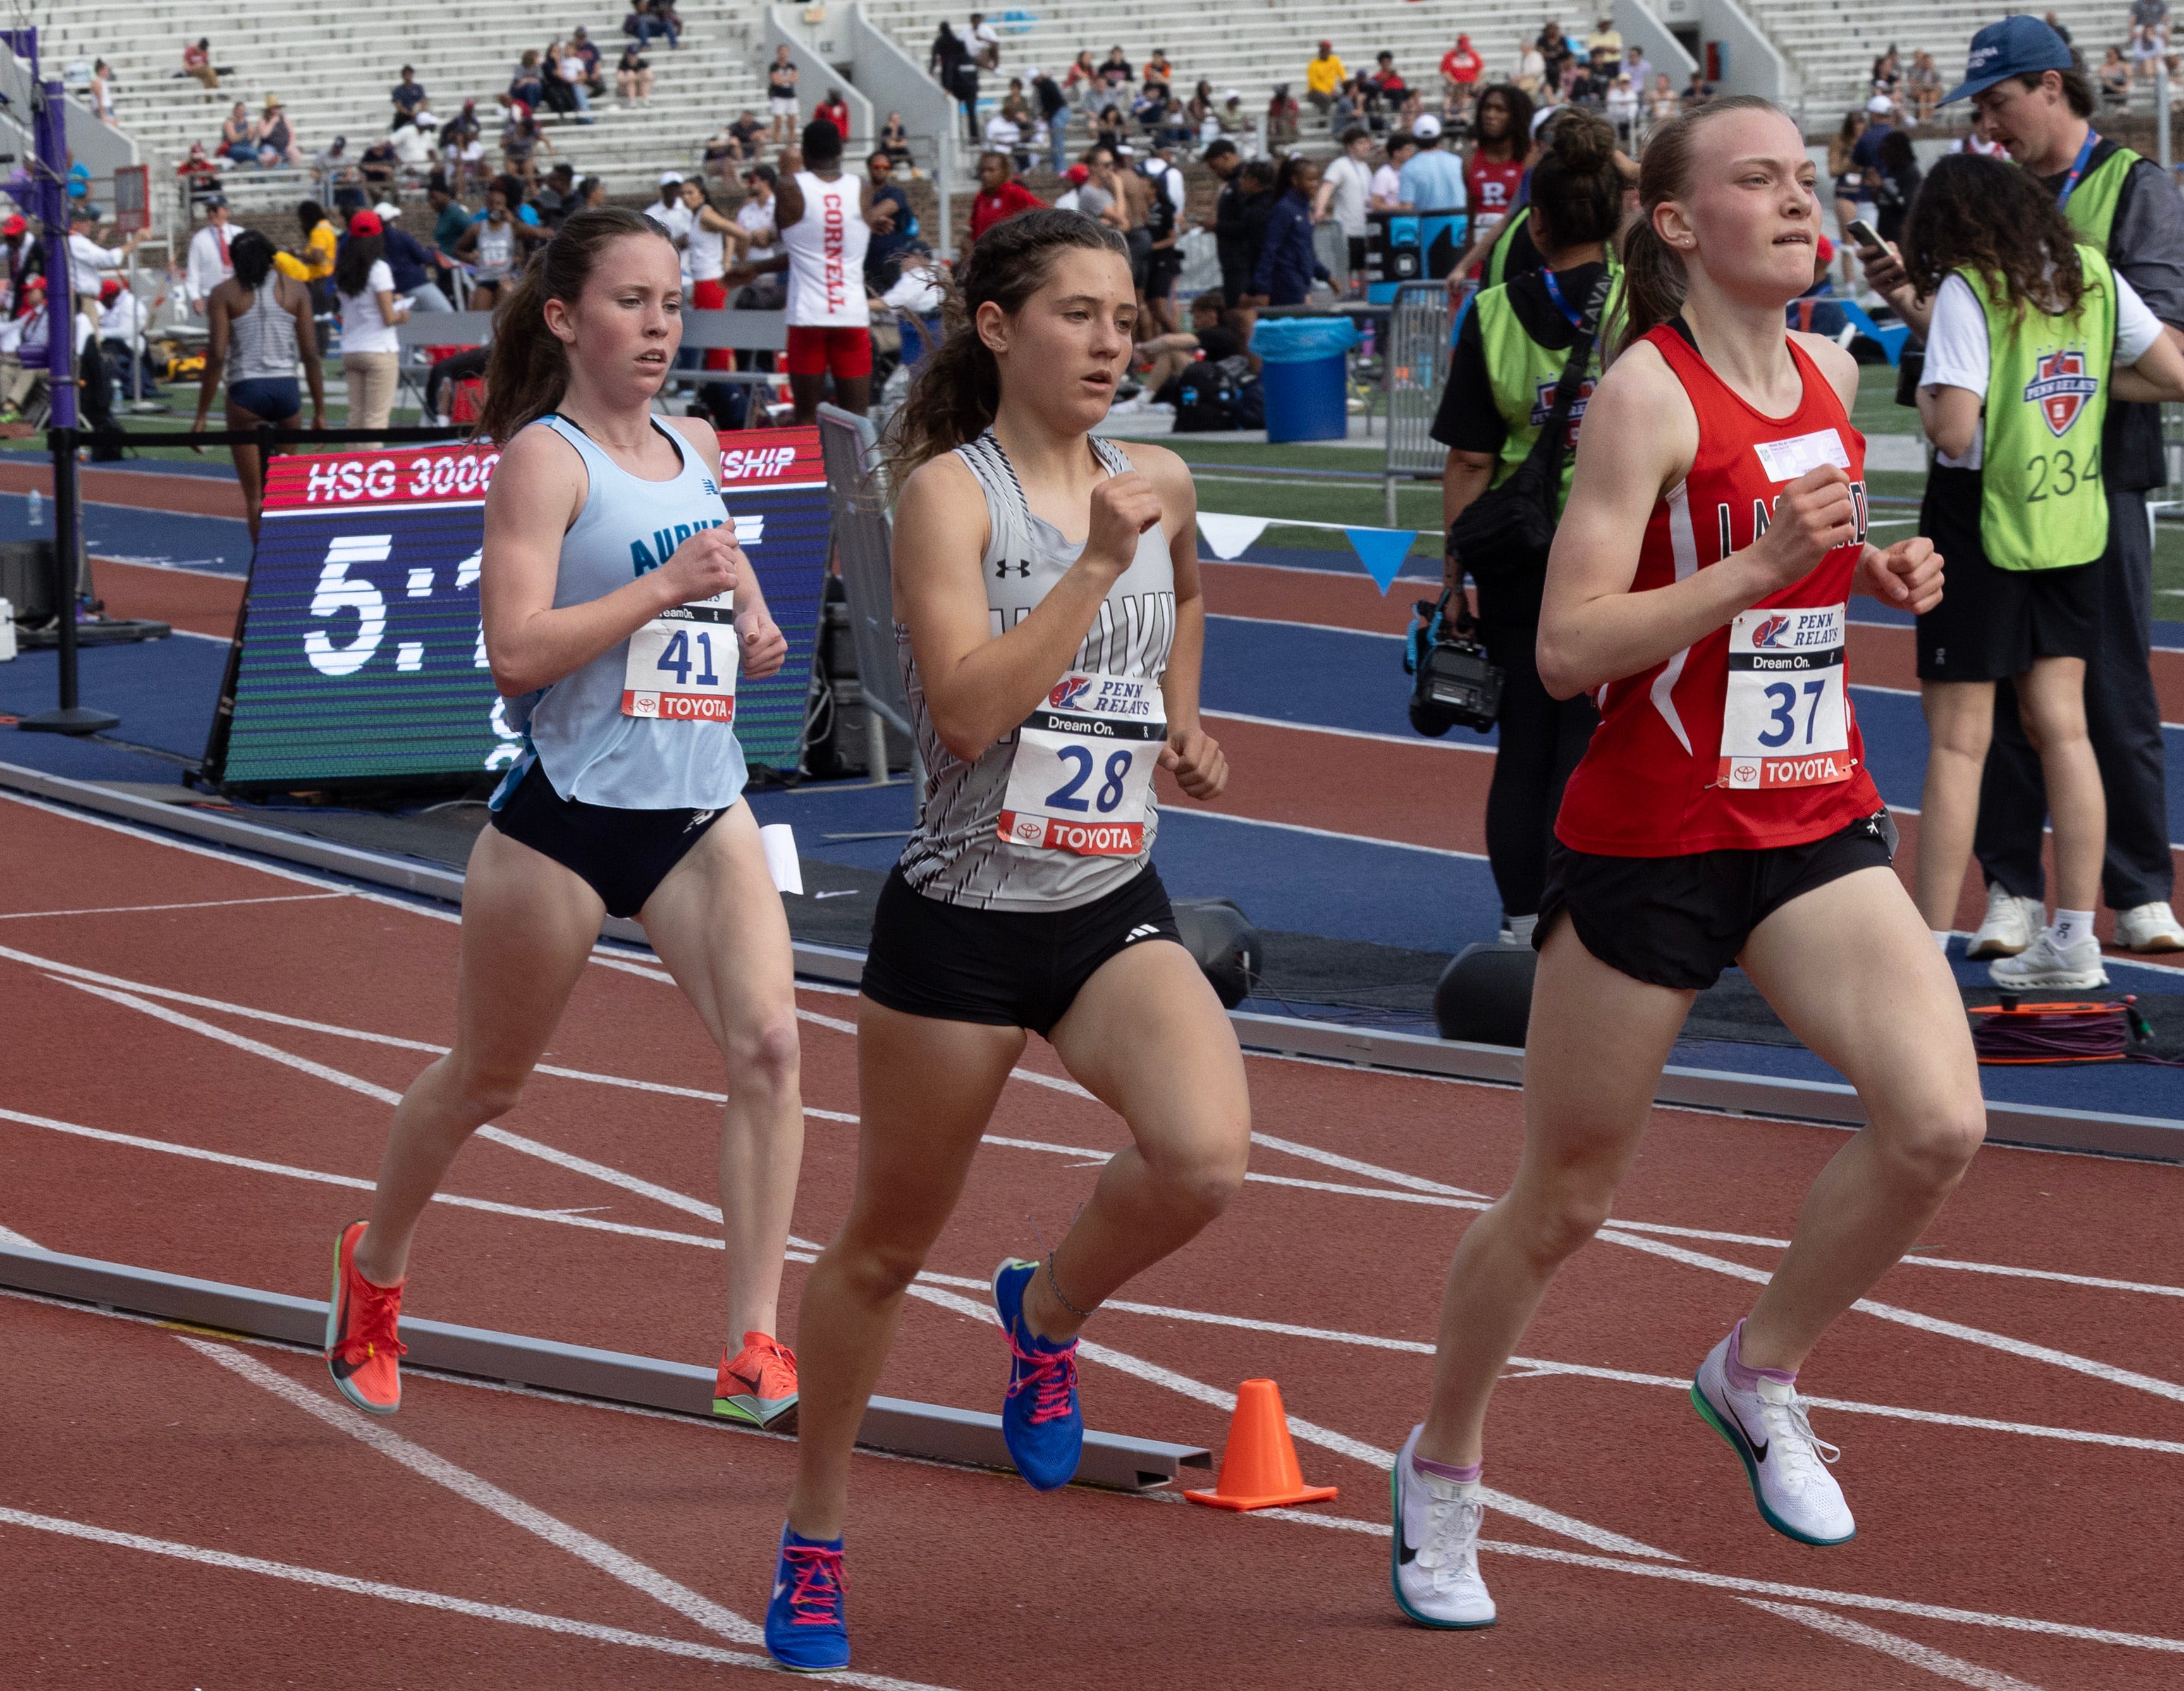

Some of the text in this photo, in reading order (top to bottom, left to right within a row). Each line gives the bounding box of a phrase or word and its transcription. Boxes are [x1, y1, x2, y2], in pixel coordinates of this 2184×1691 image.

[1482, 181, 1507, 206] R
[824, 194, 845, 314] CORNELL
[307, 459, 396, 501] HSG
[2027, 445, 2099, 502] 234
[1798, 612, 1834, 629] PENN
[1794, 627, 1838, 646] RELAYS
[657, 630, 718, 686] 41
[1753, 655, 1810, 668] Dream On.
[1100, 681, 1144, 698] PENN
[665, 697, 727, 717] TOYOTA
[1093, 697, 1150, 715] RELAYS
[1757, 679, 1825, 747] 37
[1048, 716, 1091, 733] Dream
[1093, 722, 1114, 735] On.
[1045, 745, 1133, 813] 28
[1766, 758, 1839, 782] TOYOTA
[1053, 825, 1132, 849] TOYOTA
